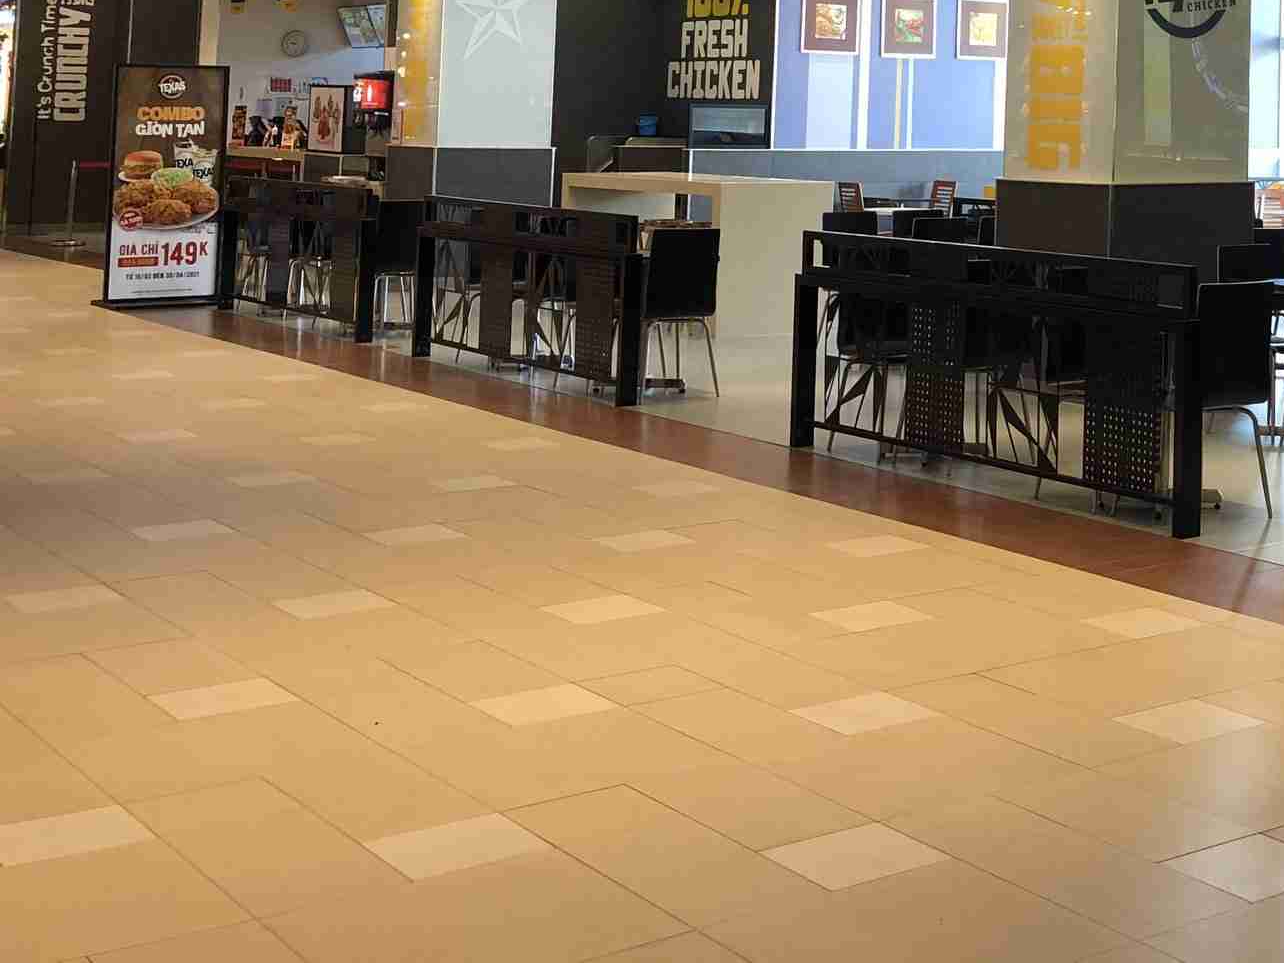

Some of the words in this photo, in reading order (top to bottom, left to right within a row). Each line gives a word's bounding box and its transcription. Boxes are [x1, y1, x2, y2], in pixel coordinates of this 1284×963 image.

[680, 19, 749, 59] FRESH
[37, 37, 55, 93] Crunch
[53, 6, 91, 121] CRUNCHY
[667, 60, 760, 100] CHICKEN
[158, 80, 186, 94] TEXAS
[37, 95, 52, 120] It's
[137, 106, 205, 121] COMBO
